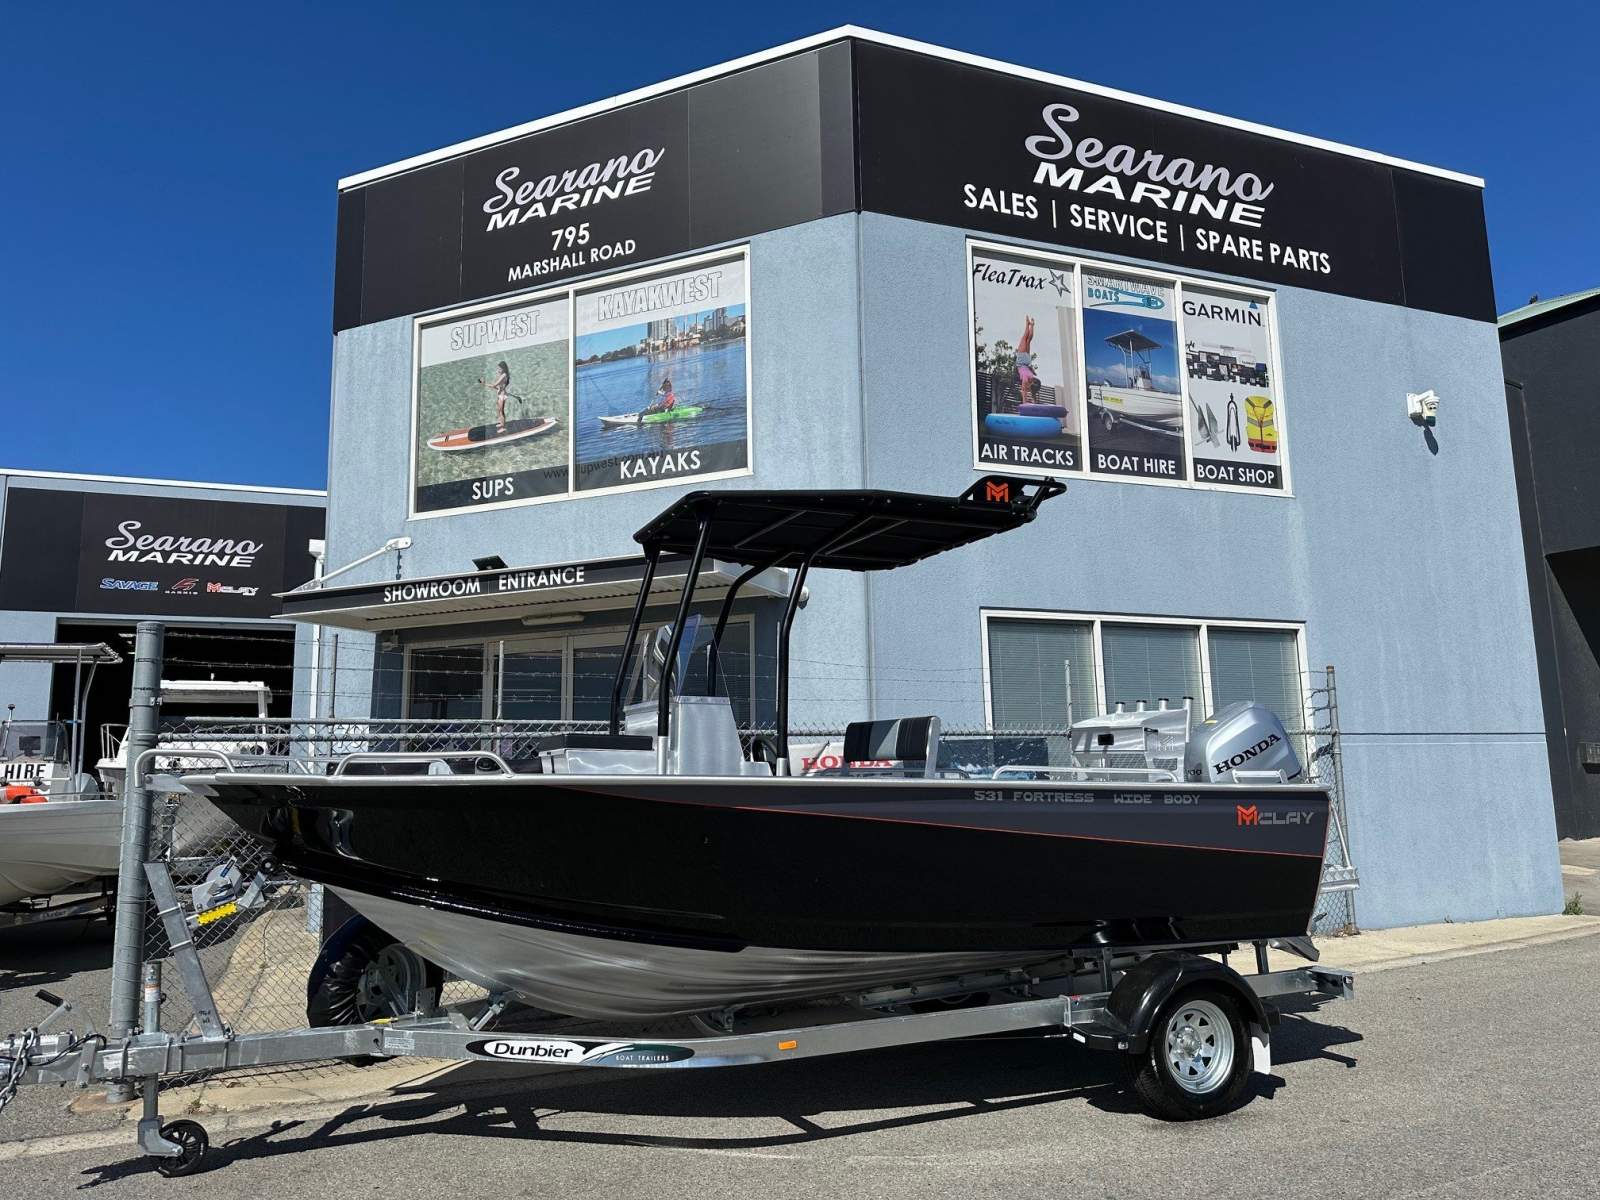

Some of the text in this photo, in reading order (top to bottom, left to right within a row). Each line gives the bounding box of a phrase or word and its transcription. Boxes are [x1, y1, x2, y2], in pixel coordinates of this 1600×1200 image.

[1025, 103, 1275, 202] Searano
[482, 147, 666, 213] Searano
[1033, 161, 1266, 228] MARINE
[486, 172, 656, 232] MARINE
[551, 222, 591, 251] 795
[963, 183, 1332, 275] SALES SERVICE SPARE PARTS
[507, 239, 637, 282] MARSHALL ROAD
[972, 262, 1047, 290] FleaTrax
[598, 270, 723, 321] KAYAKWEST
[1087, 287, 1120, 303] BOATS
[1182, 300, 1262, 327] GARMIN
[450, 310, 541, 351] SUPWEST
[619, 450, 701, 479] KAYAKS
[980, 443, 1074, 466] AIR TRACKS
[1097, 453, 1176, 475] BOAT HIRE
[471, 476, 514, 500] SUPS
[1196, 463, 1275, 485] BOAT SHOP
[105, 520, 264, 555] Searano
[107, 550, 255, 568] MARINE
[100, 577, 159, 591] SAVAGE
[383, 566, 585, 603] SHOWROOM ENTRANCE
[1213, 732, 1281, 775] HONDA
[4, 763, 47, 779] HIRE
[974, 790, 1200, 805] 531 FORTRESS WIDE BODY
[494, 1040, 573, 1059] Dunbier
